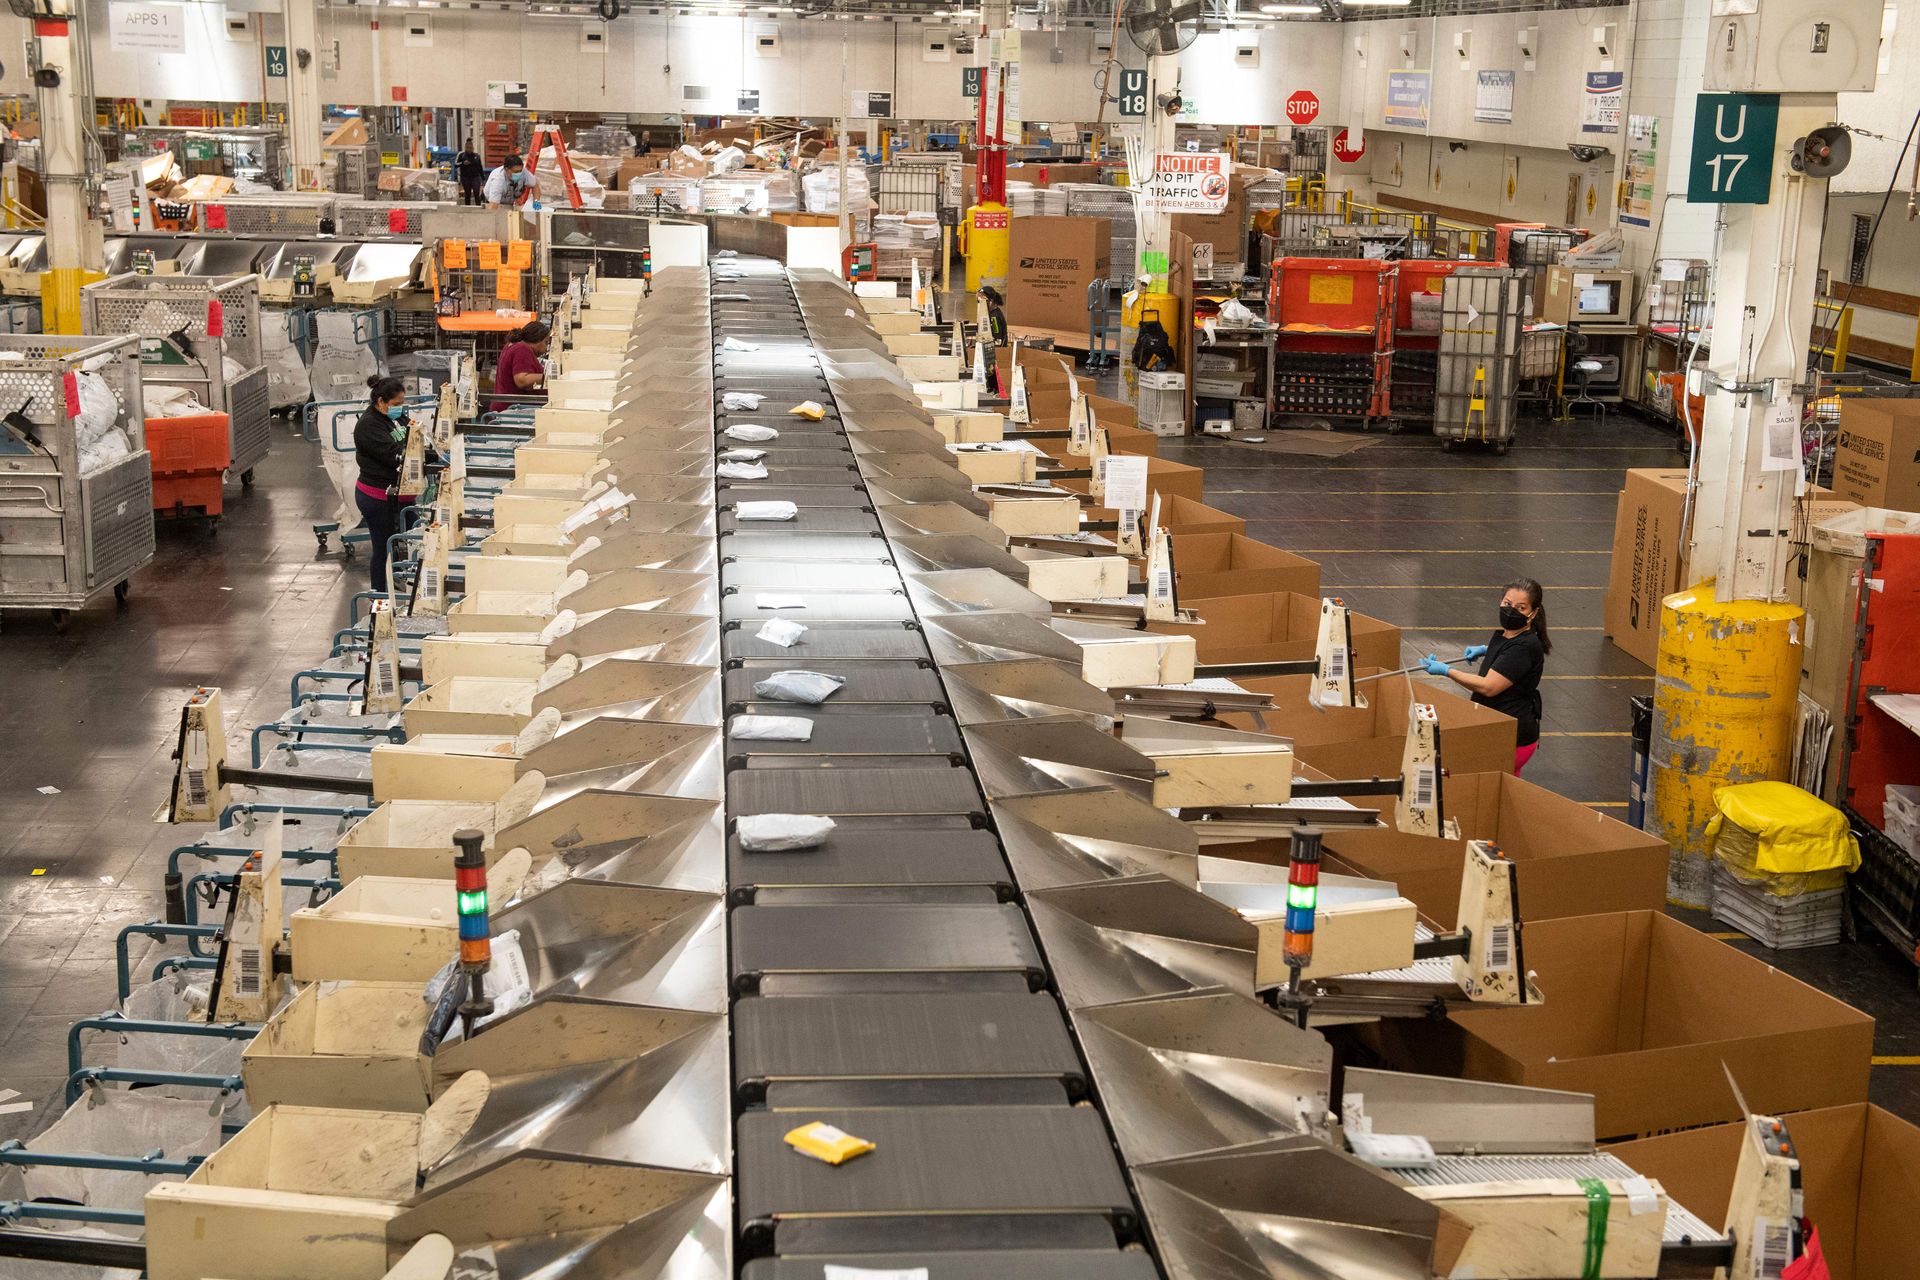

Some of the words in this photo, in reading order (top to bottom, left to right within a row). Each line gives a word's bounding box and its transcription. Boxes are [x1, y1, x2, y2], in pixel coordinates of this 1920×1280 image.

[126, 12, 158, 25] APPS
[163, 14, 168, 26] 1
[271, 49, 280, 61] V
[270, 63, 284, 75] 19
[968, 70, 977, 82] U
[966, 83, 979, 95] 19
[1127, 73, 1142, 91] U
[1122, 95, 1145, 113] 18
[1287, 101, 1318, 115] STOP
[1600, 95, 1621, 108] PRIORITY
[1715, 104, 1747, 143] U
[1160, 157, 1215, 173] NOTICE
[1156, 173, 1173, 183] NO
[1176, 174, 1194, 184] PIT
[1705, 154, 1749, 192] 17
[1149, 187, 1198, 198] TRAFFIC
[1145, 199, 1183, 208] BETWEEN
[1193, 245, 1211, 259] 68
[1850, 433, 1867, 446] UNITED
[1866, 439, 1885, 452] STATES
[1849, 441, 1864, 455] POSTAL
[1864, 447, 1885, 461] SERVICE
[1639, 504, 1648, 553] SERVICE
[1631, 550, 1639, 595] UNITED
[1635, 505, 1644, 549] STATES
[1636, 555, 1644, 600] POSTAL
